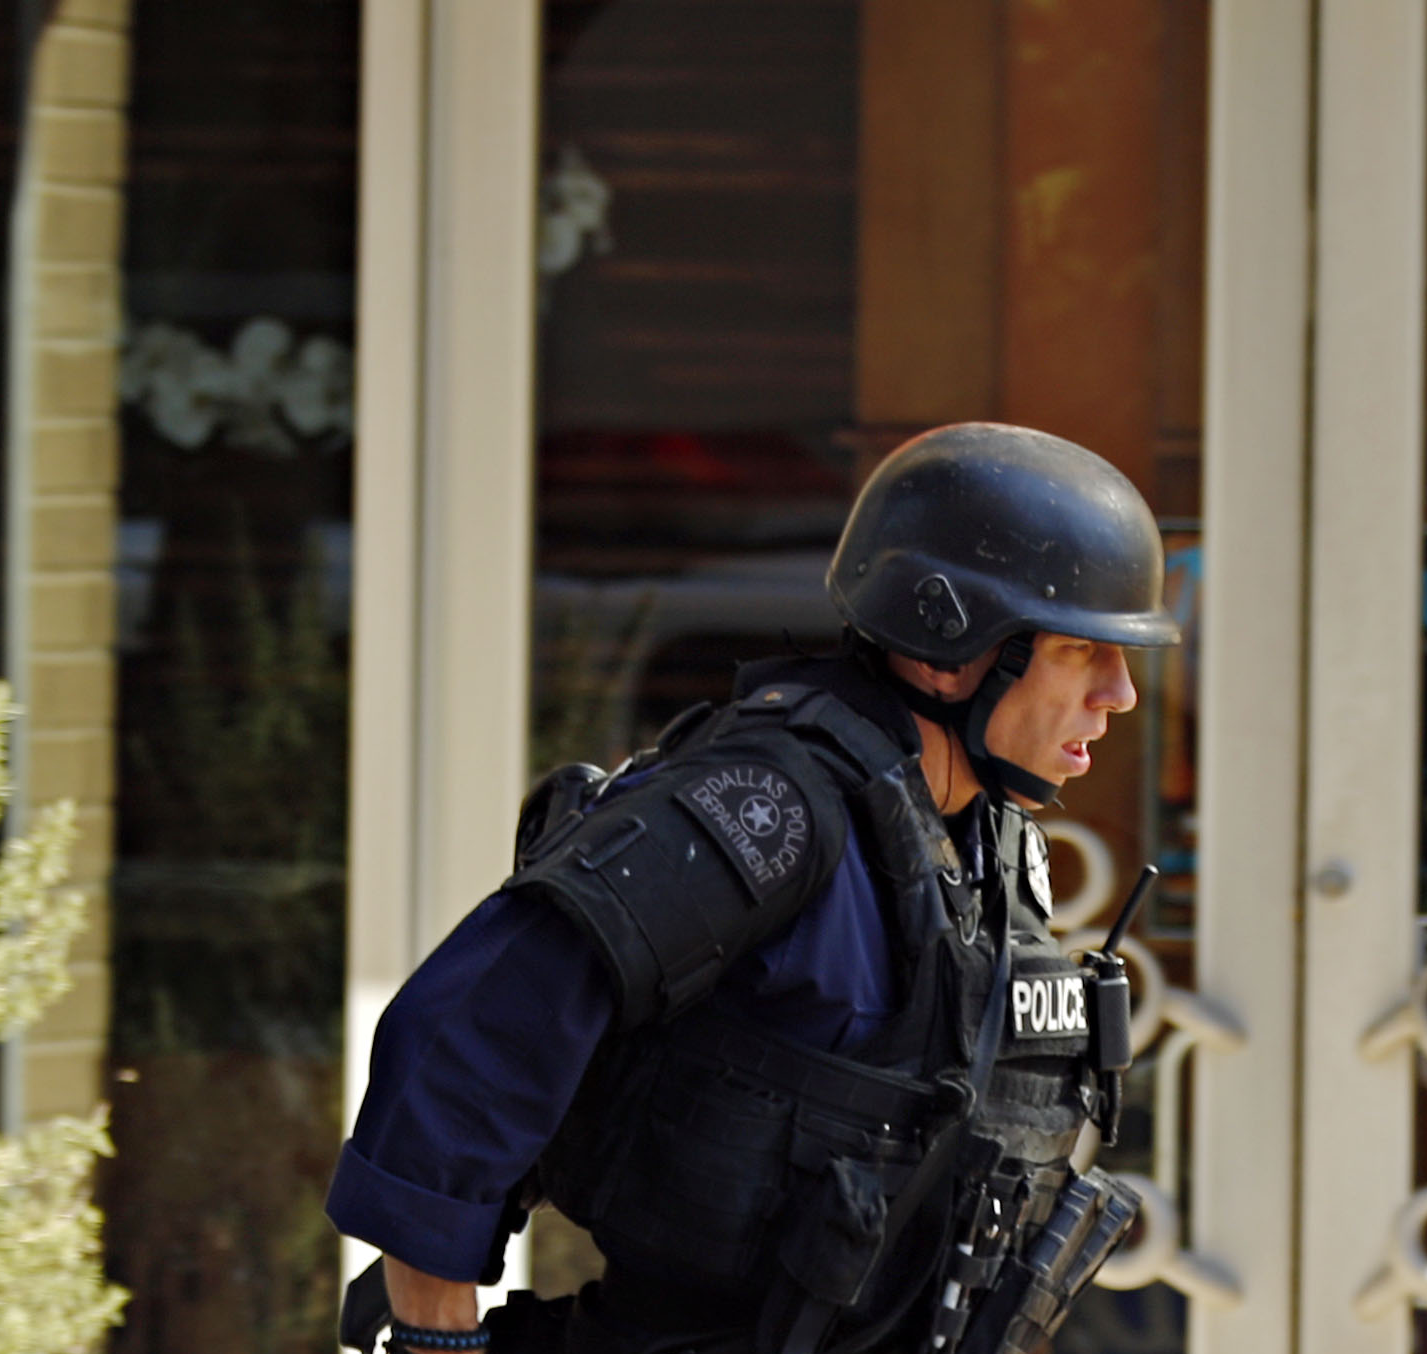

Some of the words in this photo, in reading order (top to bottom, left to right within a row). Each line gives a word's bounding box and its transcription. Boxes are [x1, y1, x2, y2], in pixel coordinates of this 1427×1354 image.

[692, 786, 776, 884] DEPARTMENT
[705, 768, 789, 800] DALLAS
[768, 805, 808, 878] POLICE
[1012, 976, 1088, 1033] POLICE
